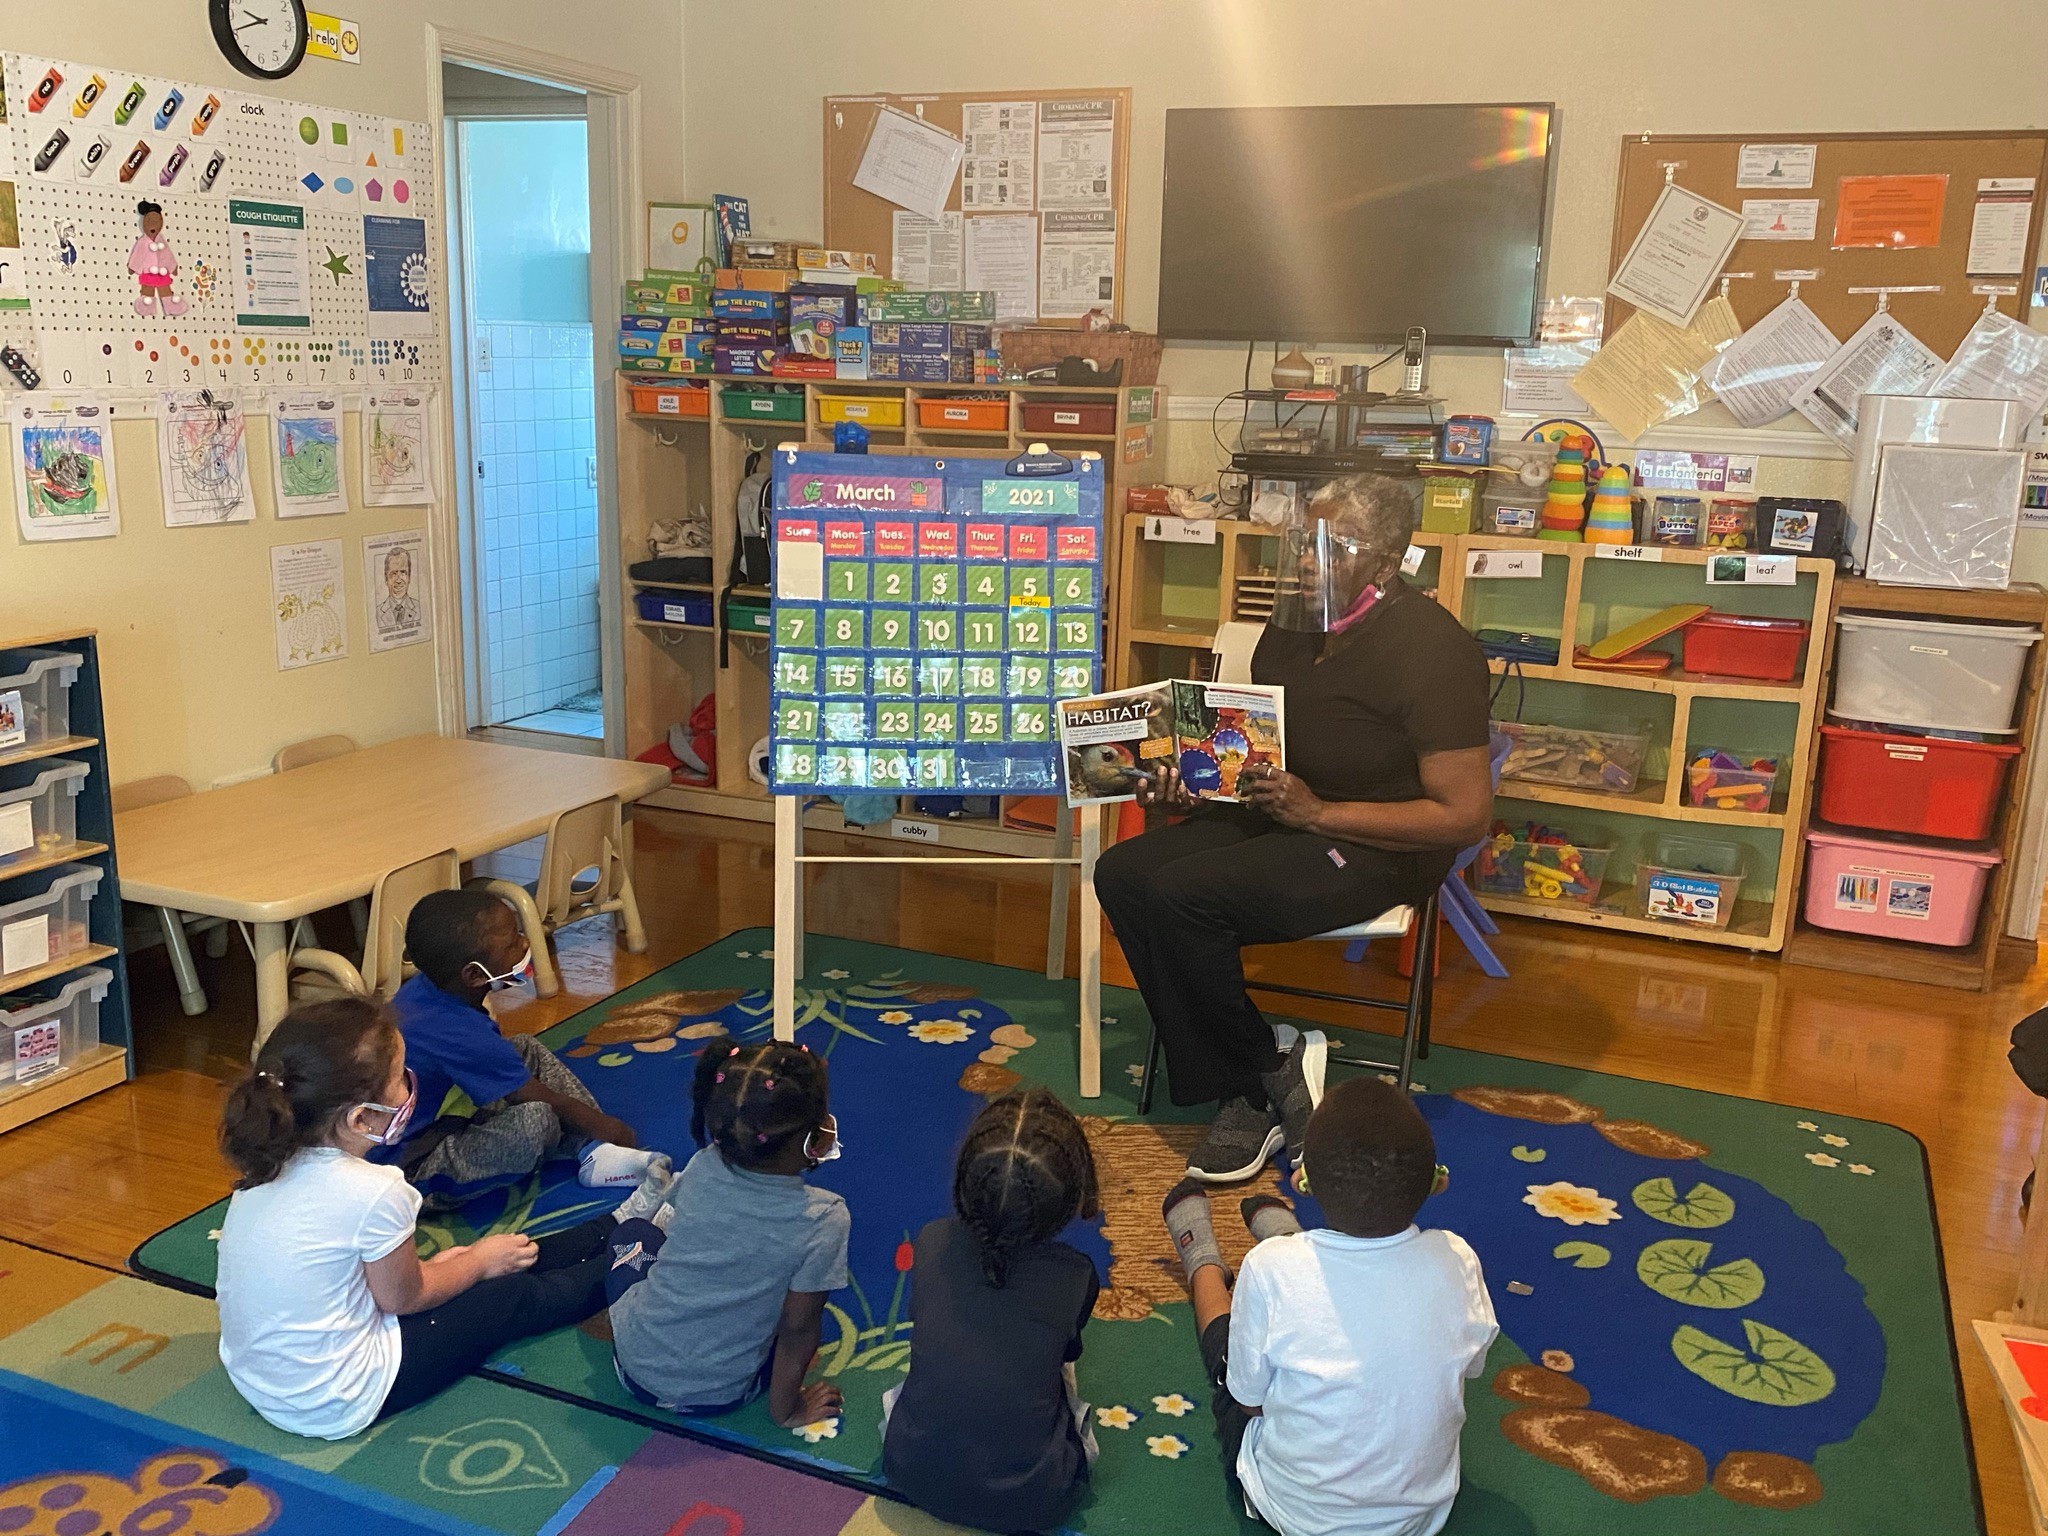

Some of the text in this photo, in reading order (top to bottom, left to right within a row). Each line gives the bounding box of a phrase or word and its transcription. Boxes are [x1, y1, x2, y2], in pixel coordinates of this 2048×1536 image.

[316, 30, 339, 54] reloj
[240, 102, 265, 116] clock
[1052, 102, 1103, 111] CHOKING/CPR
[734, 201, 747, 213] CAT
[236, 210, 298, 224] COUGH ETIQUETTE
[1055, 213, 1104, 222] CHOKING/CPR
[731, 298, 742, 306] THE
[744, 299, 768, 309] LETTER
[752, 328, 771, 337] LETTER
[64, 370, 72, 384] 0
[106, 370, 112, 383] 1
[145, 369, 153, 383] 2
[183, 369, 190, 382] 3
[219, 369, 227, 382] 4
[253, 369, 260, 382] 5
[286, 369, 293, 382] 6
[319, 368, 326, 382] 7
[349, 368, 356, 381] 8
[378, 368, 385, 381] 9
[403, 368, 413, 380] 10
[1640, 462, 1721, 480] la estantería
[836, 484, 895, 501] March
[1009, 489, 1054, 506] 2021
[831, 530, 858, 540] Mon.
[880, 529, 906, 540] Tues.
[926, 529, 952, 541] Wed.
[971, 531, 995, 541] Thur.
[1019, 533, 1036, 543] Fri.
[1066, 534, 1087, 545] Sat.
[1183, 527, 1201, 535] tree
[831, 543, 856, 551] Monday
[879, 543, 905, 552] Tuesday
[970, 544, 1000, 553] Thursday
[1614, 547, 1642, 558] shelf
[1508, 561, 1523, 570] owl
[1756, 565, 1776, 575] leaf
[844, 571, 1081, 598] 1 2 3 4 5 6
[1018, 597, 1042, 607] Today
[790, 619, 1088, 643] 7 8 9 10 11 12 13
[784, 665, 1089, 688] 14 15 16 17 18 19 20
[1067, 701, 1151, 726] HABITAT?
[786, 710, 813, 732] 21
[881, 711, 910, 733] 23
[923, 712, 953, 733] 24
[969, 712, 998, 734] 25
[1016, 712, 1045, 734] 26
[873, 757, 903, 779] 30
[922, 759, 947, 780] 31
[902, 826, 927, 837] cubby
[1686, 885, 1718, 894] Builders
[604, 1174, 637, 1184] Hanes
